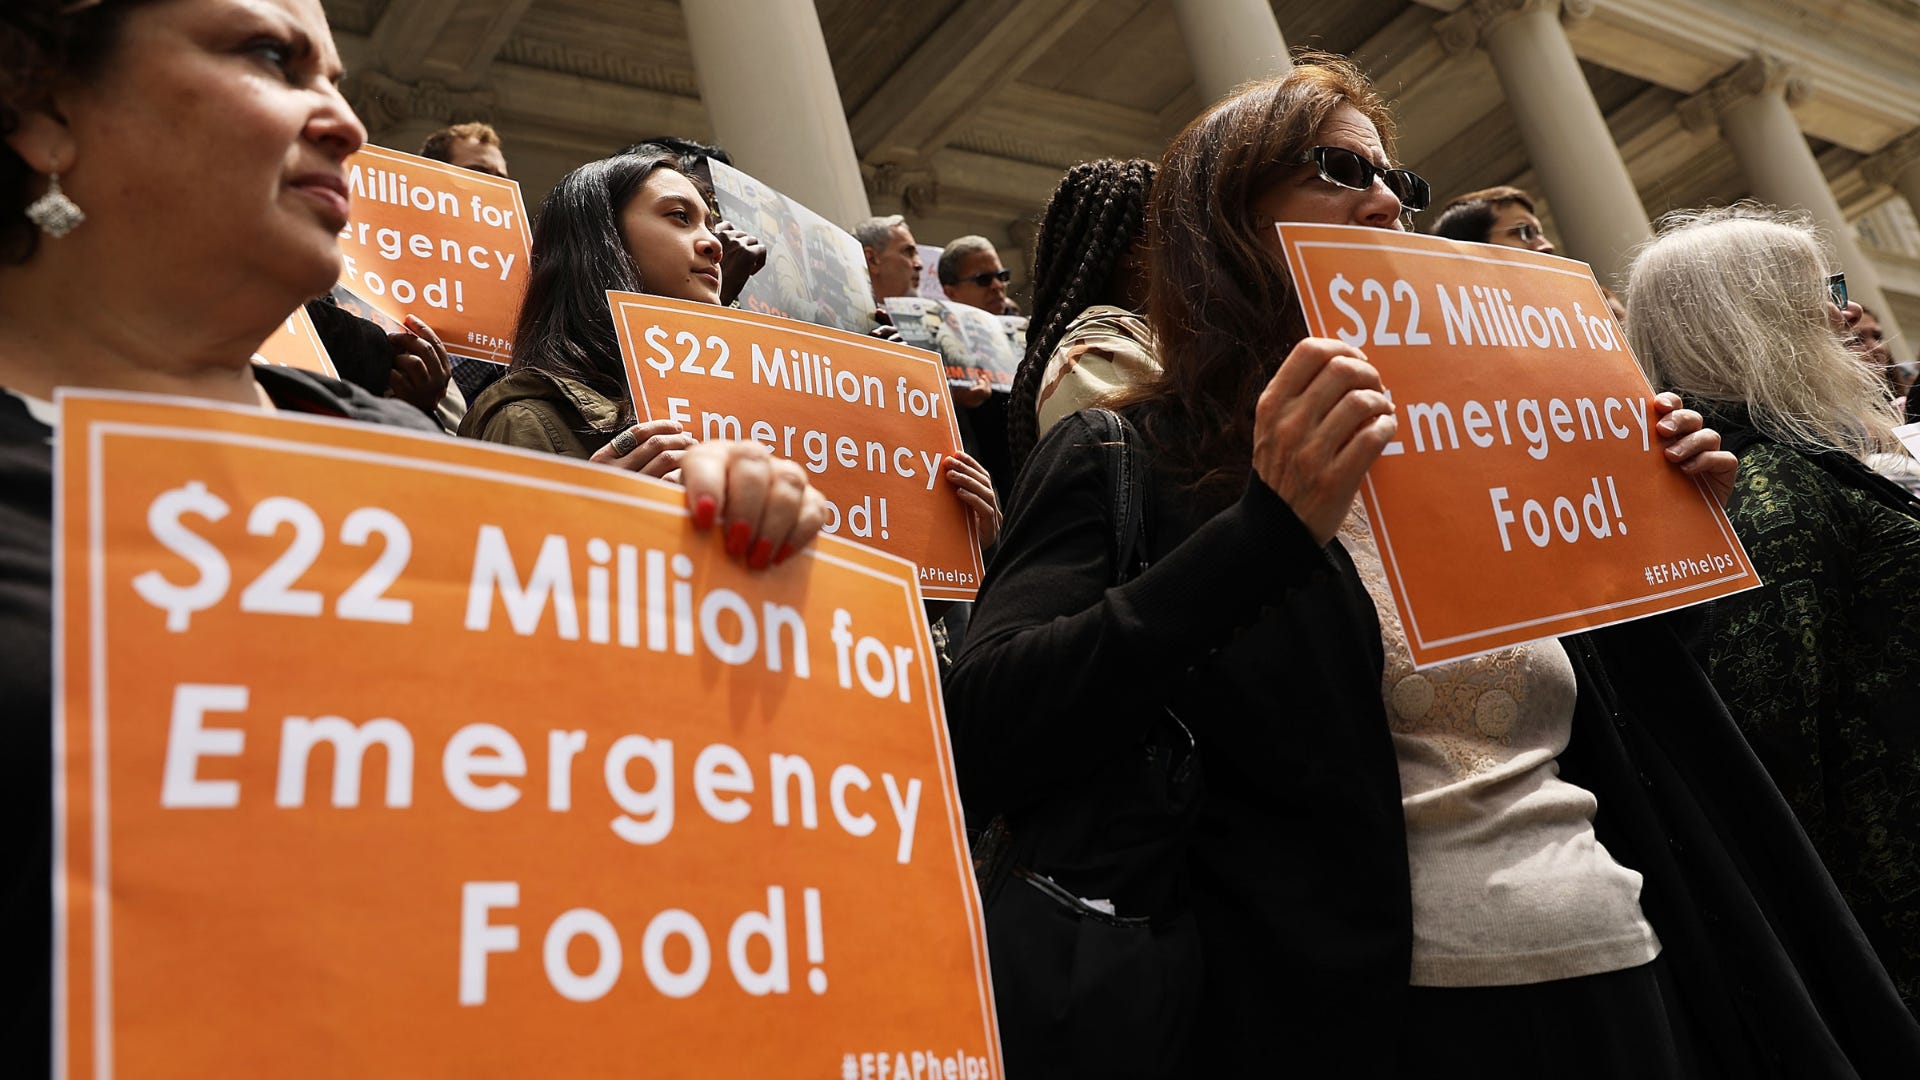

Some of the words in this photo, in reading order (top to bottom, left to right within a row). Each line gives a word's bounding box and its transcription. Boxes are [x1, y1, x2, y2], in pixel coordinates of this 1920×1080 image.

[470, 195, 513, 230] for
[338, 221, 515, 281] rgency
[342, 254, 464, 313] Food!
[1328, 273, 1431, 349] $22
[1436, 283, 1577, 349] Million
[1572, 301, 1621, 352] for
[467, 331, 512, 351] #EFAPh
[644, 324, 735, 379] $22
[751, 343, 885, 409] Million
[896, 376, 941, 419] for
[820, 495, 889, 540] od!
[1489, 476, 1628, 552] Food!
[131, 480, 414, 634] $22
[464, 523, 810, 679] Million
[831, 607, 915, 704] for
[919, 566, 974, 586] APhelps
[1644, 553, 1734, 586] #EFAPhelps
[160, 683, 922, 865] Emergency
[458, 880, 830, 1007] Food!
[841, 1049, 990, 1080] #EFAPhelps
